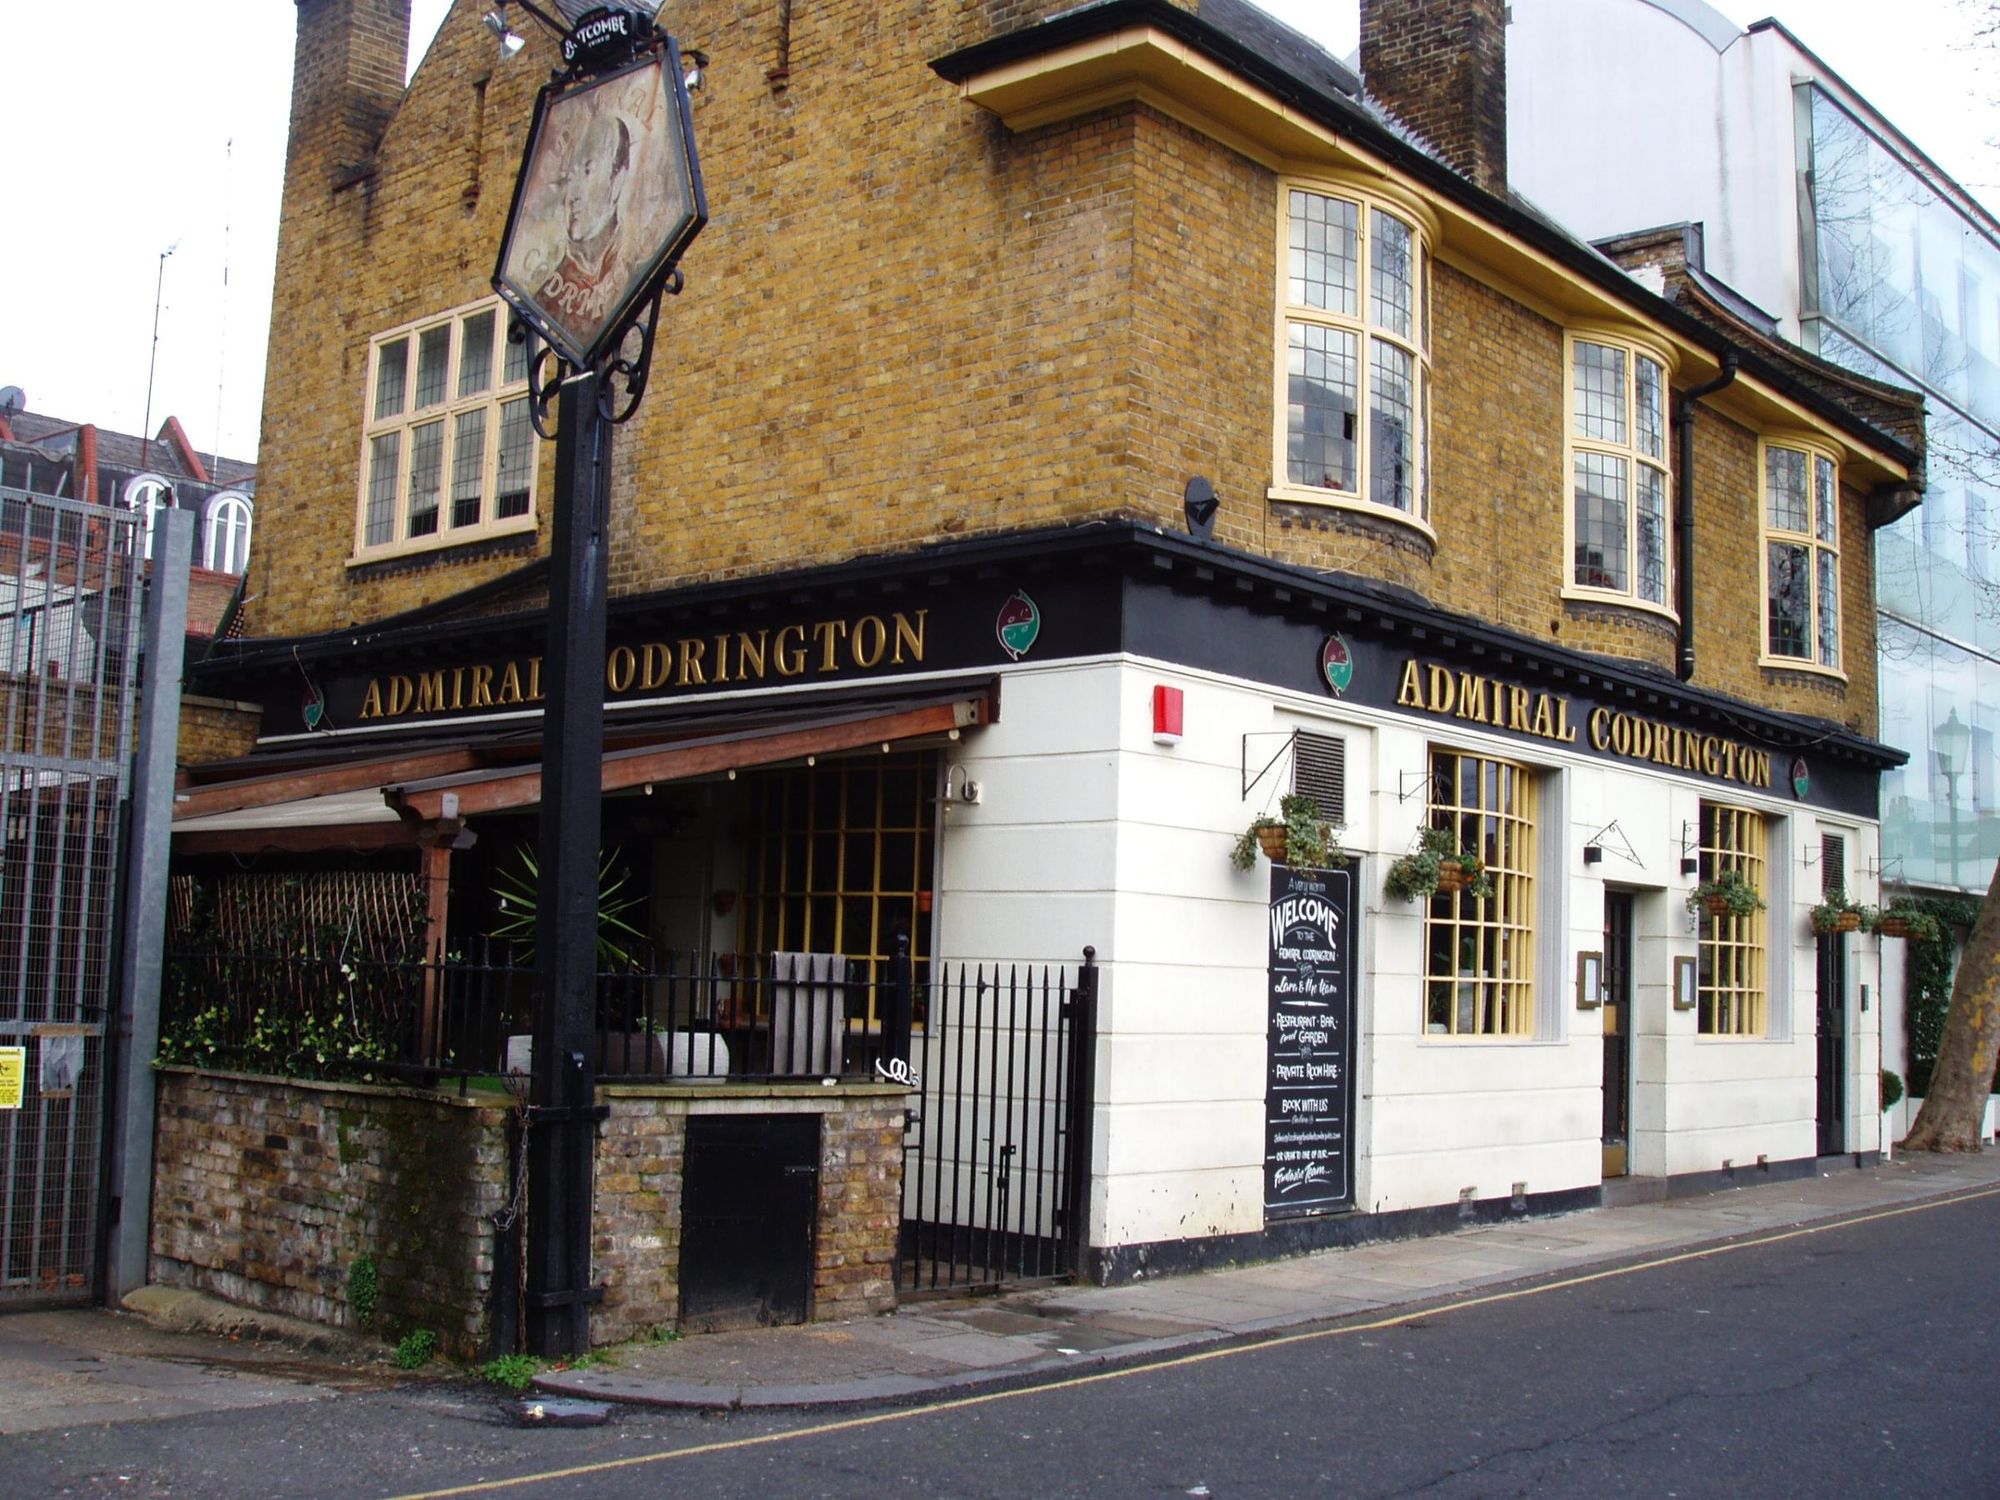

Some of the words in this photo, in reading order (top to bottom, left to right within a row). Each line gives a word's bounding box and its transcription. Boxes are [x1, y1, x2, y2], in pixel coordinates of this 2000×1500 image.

[359, 655, 546, 719] ADMIRAL
[607, 608, 928, 692] ODRINGTON
[1397, 658, 1576, 744] ADMIRAL
[1591, 707, 1771, 788] CODRINGTON
[1271, 898, 1339, 950] WELCOME
[1276, 1012, 1316, 1031] RESTAURANT
[1320, 1014, 1337, 1030] BAR
[1298, 1030, 1328, 1047] GARDEN
[1276, 1063, 1305, 1081] PRIVATE
[1306, 1062, 1323, 1080] ROOM
[1323, 1063, 1338, 1079] HIRE
[1282, 1098, 1301, 1113] BOOK
[1301, 1098, 1318, 1112] WITH
[1318, 1098, 1328, 1112] US
